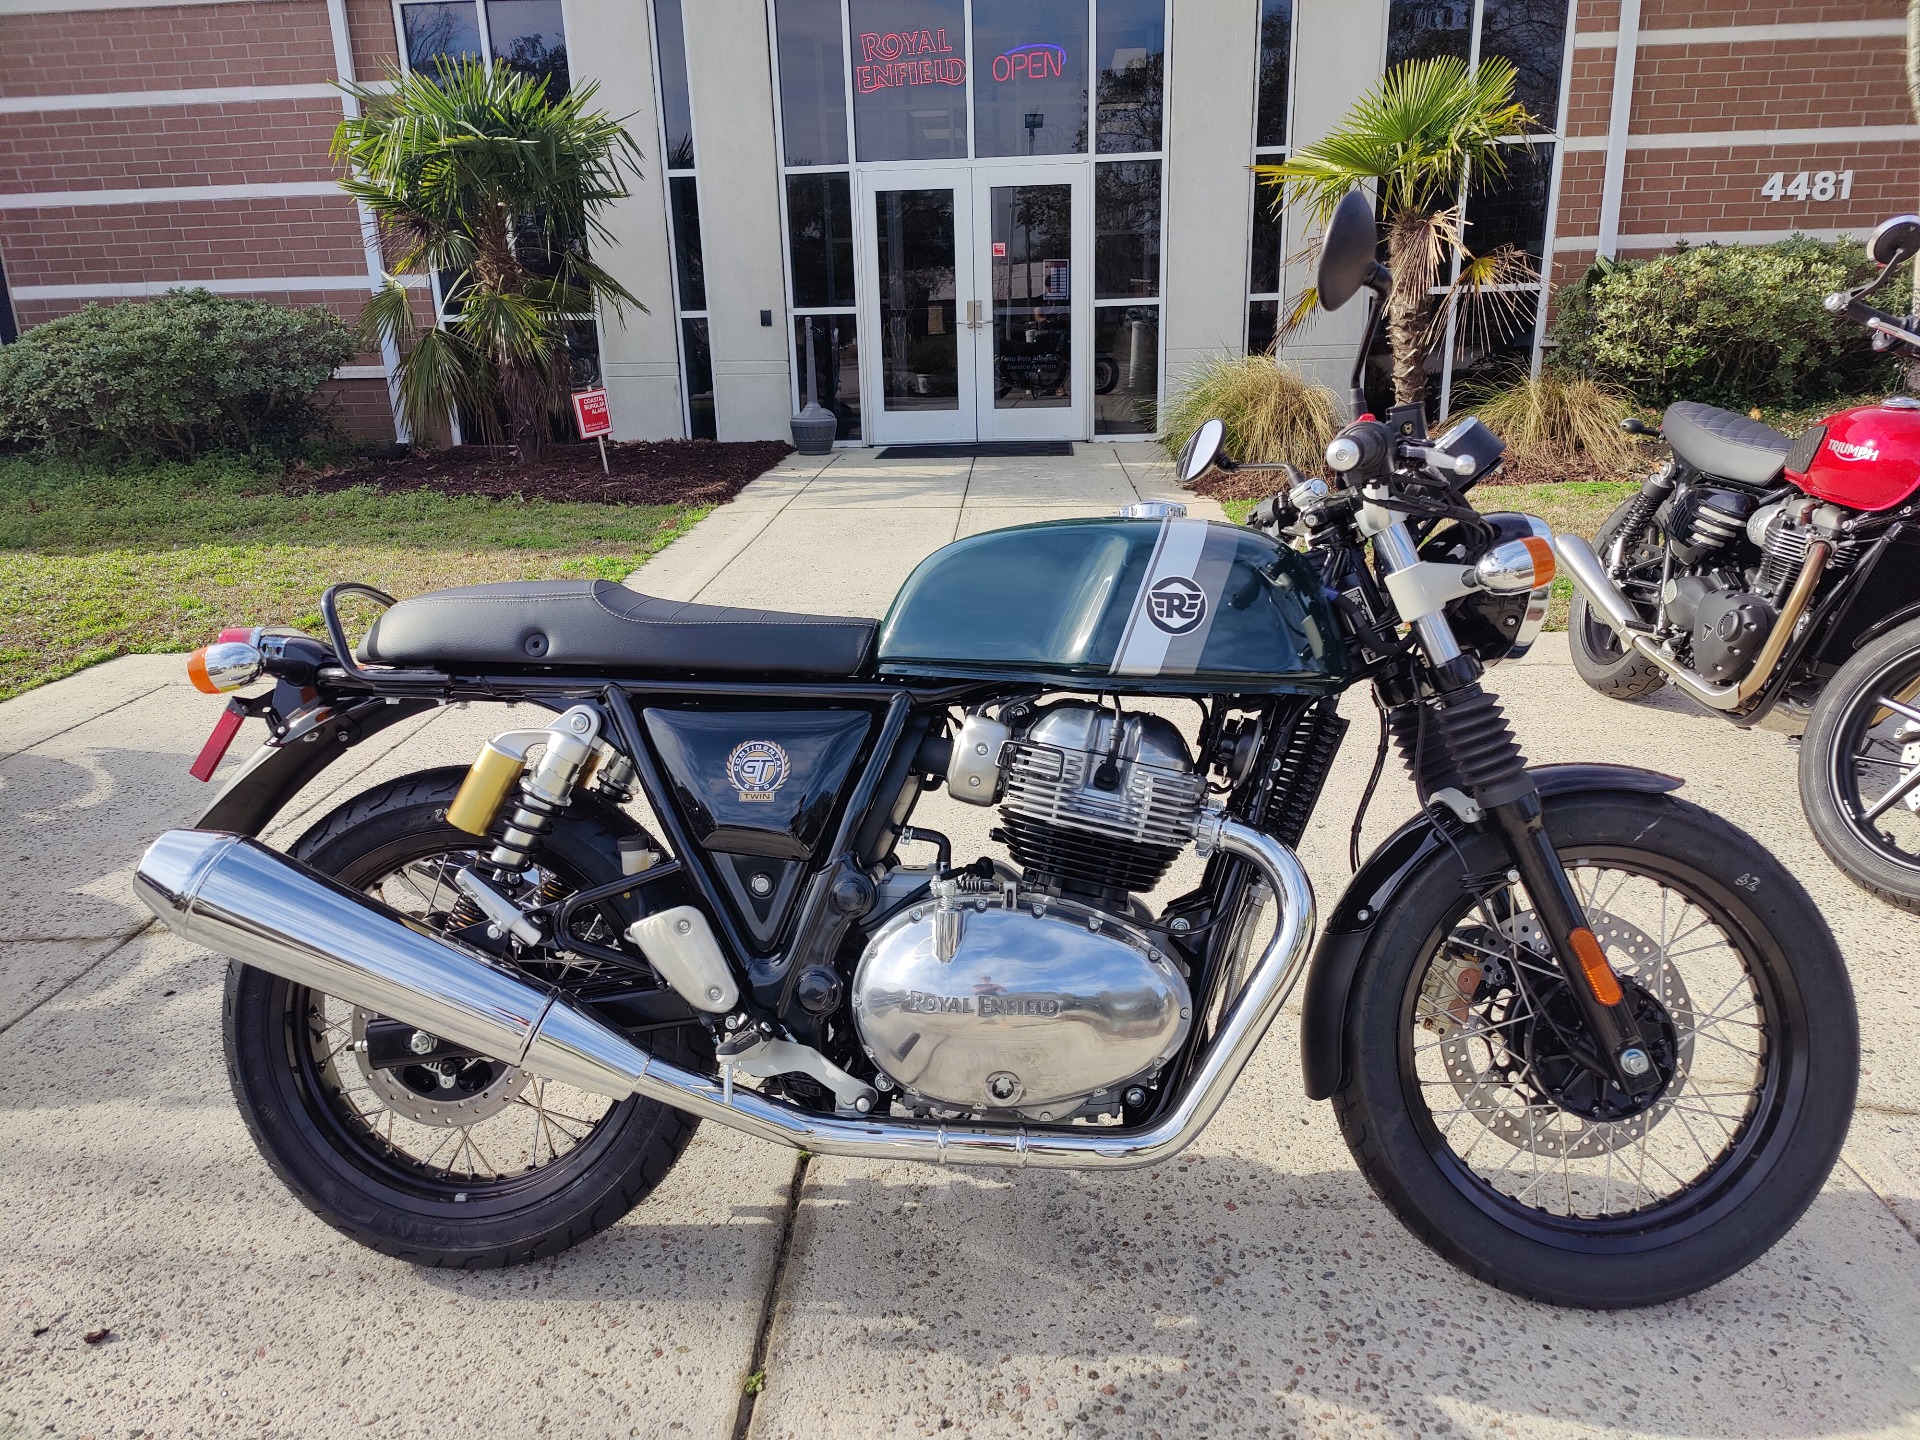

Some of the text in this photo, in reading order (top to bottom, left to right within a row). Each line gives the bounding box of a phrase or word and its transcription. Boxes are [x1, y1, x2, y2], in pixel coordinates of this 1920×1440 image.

[860, 29, 953, 62] ROYAL
[857, 58, 966, 93] ENFIELD
[992, 51, 1062, 82] OPEN
[1761, 169, 1854, 202] 4481
[1827, 439, 1880, 462] TRIUMPH
[733, 744, 782, 773] CONTINENTAL
[742, 756, 775, 785] GT
[910, 990, 1061, 1018] ROYAL ENFIELD
